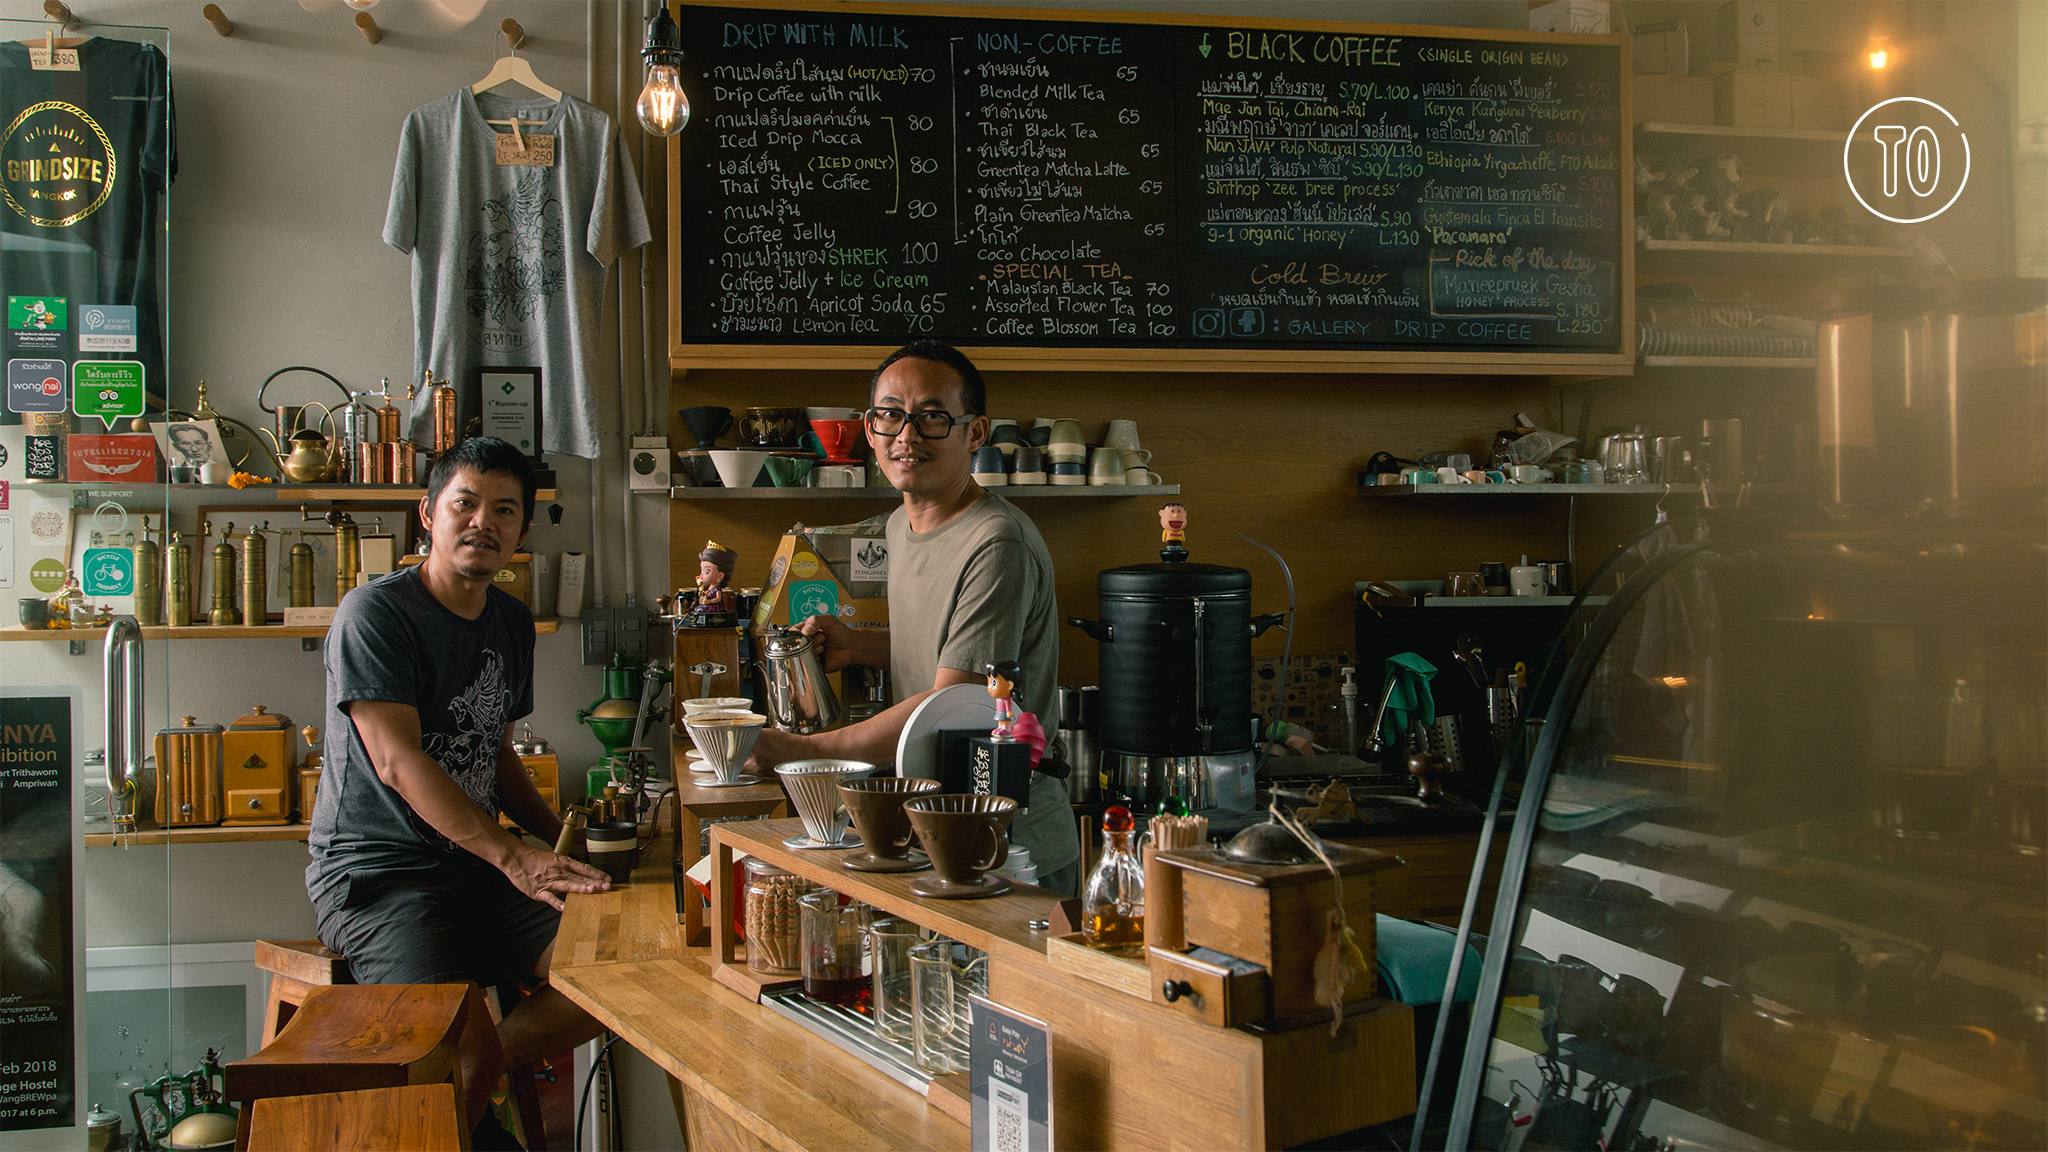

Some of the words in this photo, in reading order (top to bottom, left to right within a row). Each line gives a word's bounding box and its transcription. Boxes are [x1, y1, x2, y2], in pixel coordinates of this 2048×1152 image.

[723, 22, 776, 49] DRIP
[783, 22, 836, 47] WITH
[849, 23, 909, 49] MILK
[1038, 33, 1123, 55] COFFEE
[1227, 31, 1306, 63] BLACK
[1313, 34, 1402, 67] COFFEE
[1481, 49, 1523, 66] ORIGIN
[909, 67, 936, 83] 70
[1116, 65, 1138, 81] 65
[713, 86, 753, 108] Drip
[757, 84, 804, 102] Coffee
[811, 84, 844, 102] with
[849, 83, 882, 102] milk
[979, 84, 1039, 101] Blended
[1045, 84, 1077, 100] Milk
[1078, 84, 1105, 101] Tea
[1118, 108, 1141, 125] 65
[1203, 98, 1232, 115] Mae
[1237, 100, 1262, 115] Jan
[1266, 100, 1290, 118] Tai,
[1424, 101, 1465, 120] Kenya
[1472, 101, 1525, 122] Kangunu
[907, 114, 933, 131] 80
[977, 122, 1013, 137] Thai
[1025, 123, 1067, 139] Black
[1070, 122, 1099, 139] Tea
[767, 131, 803, 152] Drip
[812, 129, 862, 146] Mocca
[1205, 136, 1235, 155] Nan
[1280, 141, 1305, 160] Pulp
[1307, 141, 1356, 157] Natural
[533, 151, 552, 162] 250
[1140, 143, 1160, 158] 65
[7, 156, 103, 184] GRINDSIZE
[910, 156, 938, 173] 80
[977, 161, 1040, 178] Greentea
[1044, 161, 1093, 177] Matcha
[1094, 161, 1131, 176] Latte
[1426, 151, 1481, 173] Ethiopia
[28, 188, 77, 201] BANGKOK
[720, 179, 759, 196] Thai
[770, 173, 814, 197] Style
[822, 173, 871, 191] Coffee
[1139, 180, 1163, 195] 65
[1305, 181, 1336, 196] bree
[908, 200, 937, 219] 90
[974, 203, 1014, 223] Plain
[1020, 203, 1081, 223] Greentea
[1083, 204, 1134, 222] Matcha
[1380, 211, 1412, 227] S.90
[1424, 207, 1491, 226] Guatemala
[1498, 207, 1530, 224] Finca
[1533, 208, 1544, 224] El
[724, 226, 783, 245] Coffee
[793, 223, 836, 249] Jelly
[1144, 223, 1165, 237] 65
[1379, 230, 1419, 246] L.130
[828, 248, 888, 266] SHREK
[901, 241, 938, 265] 100
[1020, 240, 1101, 262] Chocolate
[993, 263, 1073, 280] SPECIAL
[1502, 247, 1524, 272] of
[1527, 247, 1559, 270] the
[1561, 250, 1596, 277] day
[1250, 262, 1308, 285] Cold
[1319, 263, 1389, 285] Brew
[720, 271, 774, 290] Coffee
[780, 268, 818, 299] Jelly
[840, 270, 864, 288] Ice
[873, 269, 929, 289] Cream
[987, 279, 1058, 302] Malaysian
[1109, 281, 1133, 297] Tea
[1145, 282, 1170, 297] 70
[1445, 275, 1538, 299] Maneepruek
[809, 293, 864, 316] Apricot
[871, 293, 914, 313] Soda
[920, 292, 947, 314] 65
[985, 297, 1050, 314] Assorted
[1057, 296, 1107, 314] Flower
[1110, 298, 1136, 317] Tea
[1146, 303, 1173, 317] 100
[1456, 296, 1493, 308] HONEY
[1504, 297, 1549, 308] PROCESS
[793, 316, 846, 334] Lemon
[985, 317, 1034, 335] Coffee
[1041, 317, 1099, 336] Blossom
[1107, 318, 1137, 335] Tea
[1147, 321, 1176, 336] 100
[1288, 319, 1370, 336] GALLERY
[1394, 319, 1445, 339] DRIP
[1457, 323, 1531, 340] COFFEE
[1557, 320, 1602, 334] L.250
[101, 490, 134, 498] SUPPORT
[0, 724, 57, 744] NYA
[11, 769, 58, 777] Trithaworn
[13, 780, 58, 789] Ampriwan
[23, 1060, 57, 1073] 2018
[20, 1079, 57, 1092] Hostel
[19, 1109, 28, 1117] at
[30, 1108, 36, 1116] 6
[37, 1107, 57, 1117] p.m.
